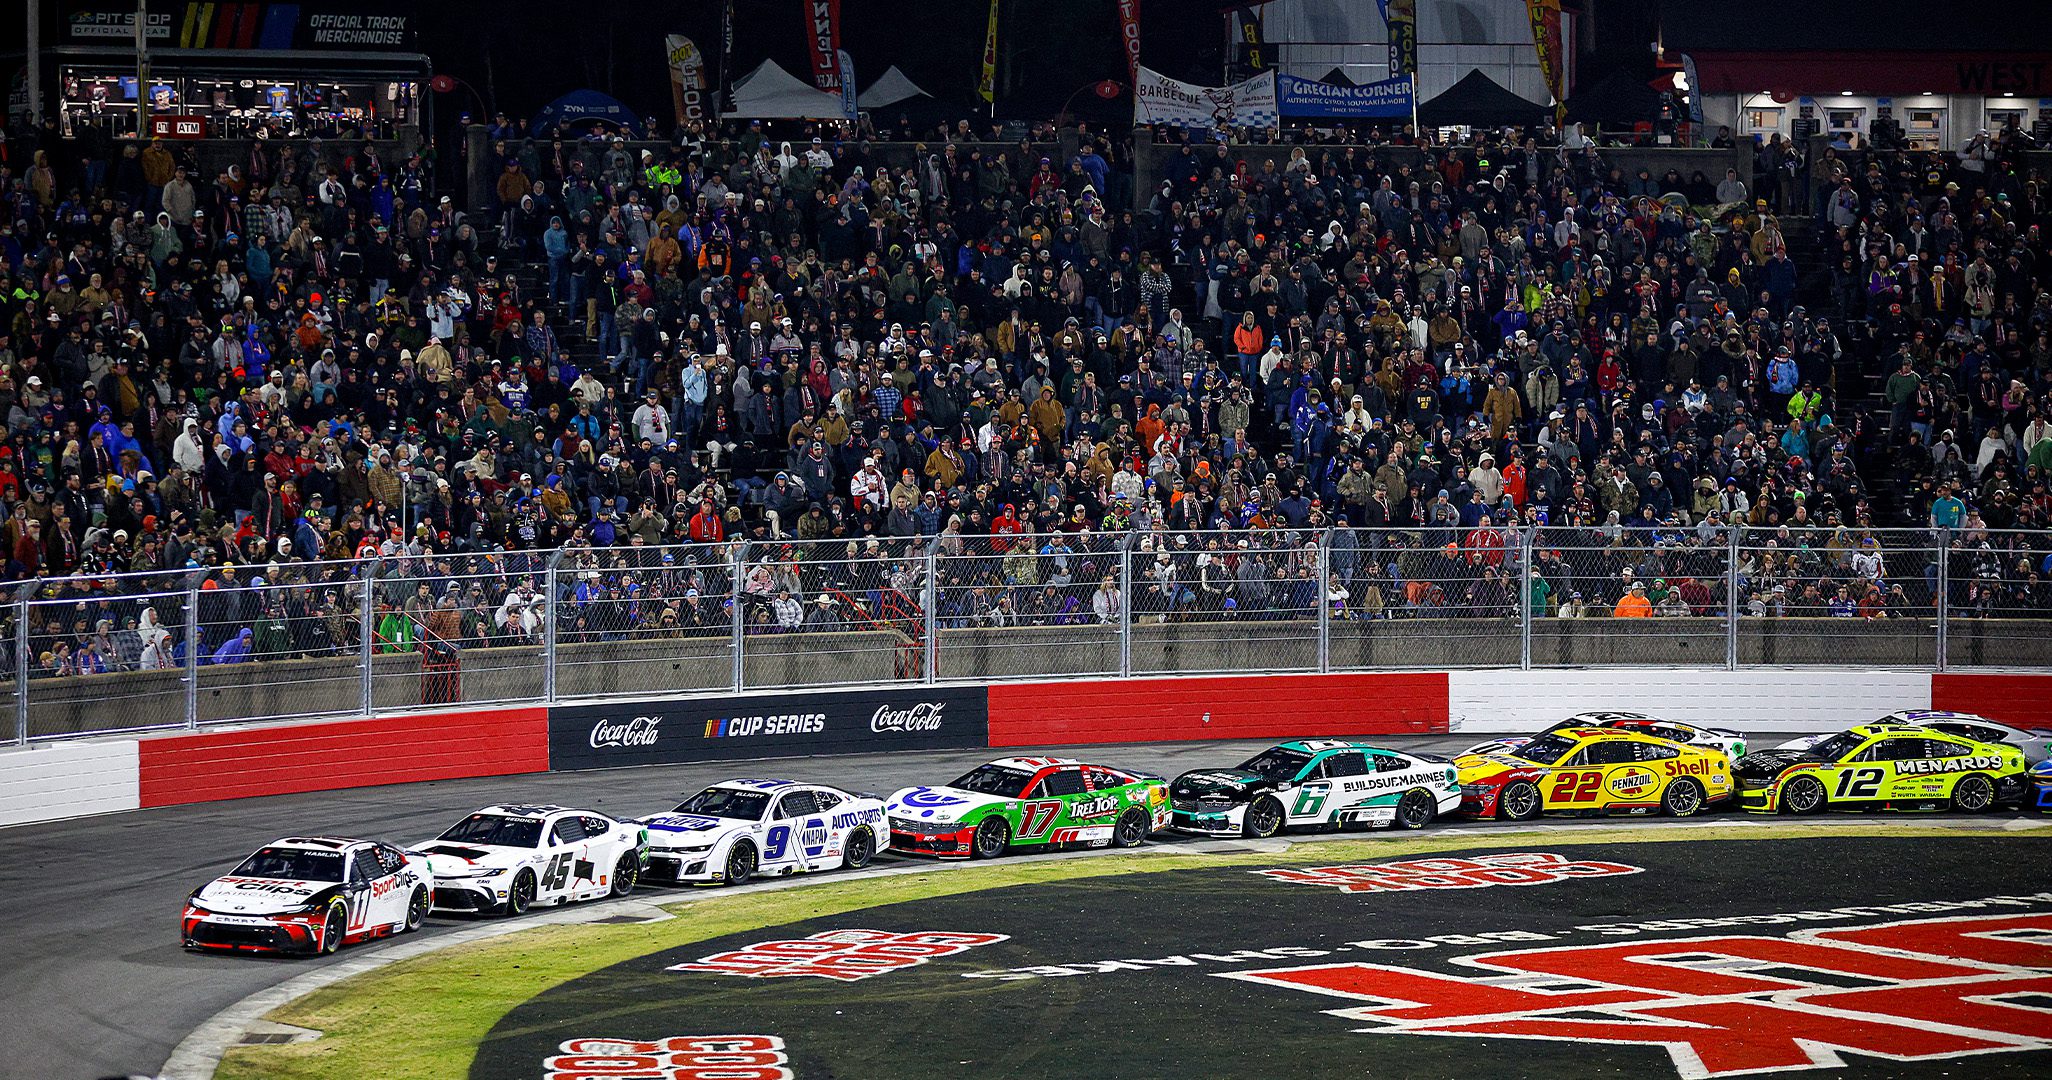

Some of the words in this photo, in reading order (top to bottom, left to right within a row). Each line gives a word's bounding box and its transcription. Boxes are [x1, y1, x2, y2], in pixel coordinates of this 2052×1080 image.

[95, 13, 123, 24] PIT
[124, 12, 171, 25] SOP
[310, 14, 363, 29] OFFICIAL
[366, 16, 406, 30] TRACK
[74, 27, 128, 35] OFFICIAL
[145, 28, 168, 36] EAR
[314, 30, 403, 45] MERCHANDISE
[671, 43, 692, 64] HOT
[1957, 63, 2043, 91] WEST
[681, 64, 703, 121] CHOC
[1140, 84, 1201, 105] BARBECUE
[1292, 81, 1352, 98] GRECIAN
[1353, 82, 1411, 98] CORNER
[564, 105, 585, 113] ZYN
[1287, 97, 1324, 105] AUTHENTIC
[178, 122, 199, 134] ATM
[729, 717, 761, 737] CUP
[765, 714, 825, 735] SERIES
[870, 702, 946, 733] Coca-Cola
[590, 716, 663, 748] Coca-Cola
[1664, 759, 1710, 776] Shell
[1895, 755, 2003, 776] MENARDS
[1549, 772, 1603, 803] 22
[1612, 774, 1653, 791] PENNZOIL
[1834, 767, 1885, 799] 12
[1289, 780, 1333, 820] 6
[832, 812, 858, 830] AUTO
[858, 808, 882, 824] PARTS
[1015, 799, 1065, 840] 17
[763, 825, 791, 860] 9
[805, 829, 826, 846] NAPA
[304, 850, 340, 858] HAMLIN
[541, 852, 573, 891] 45
[235, 883, 313, 896] Clips
[348, 887, 371, 931] 11
